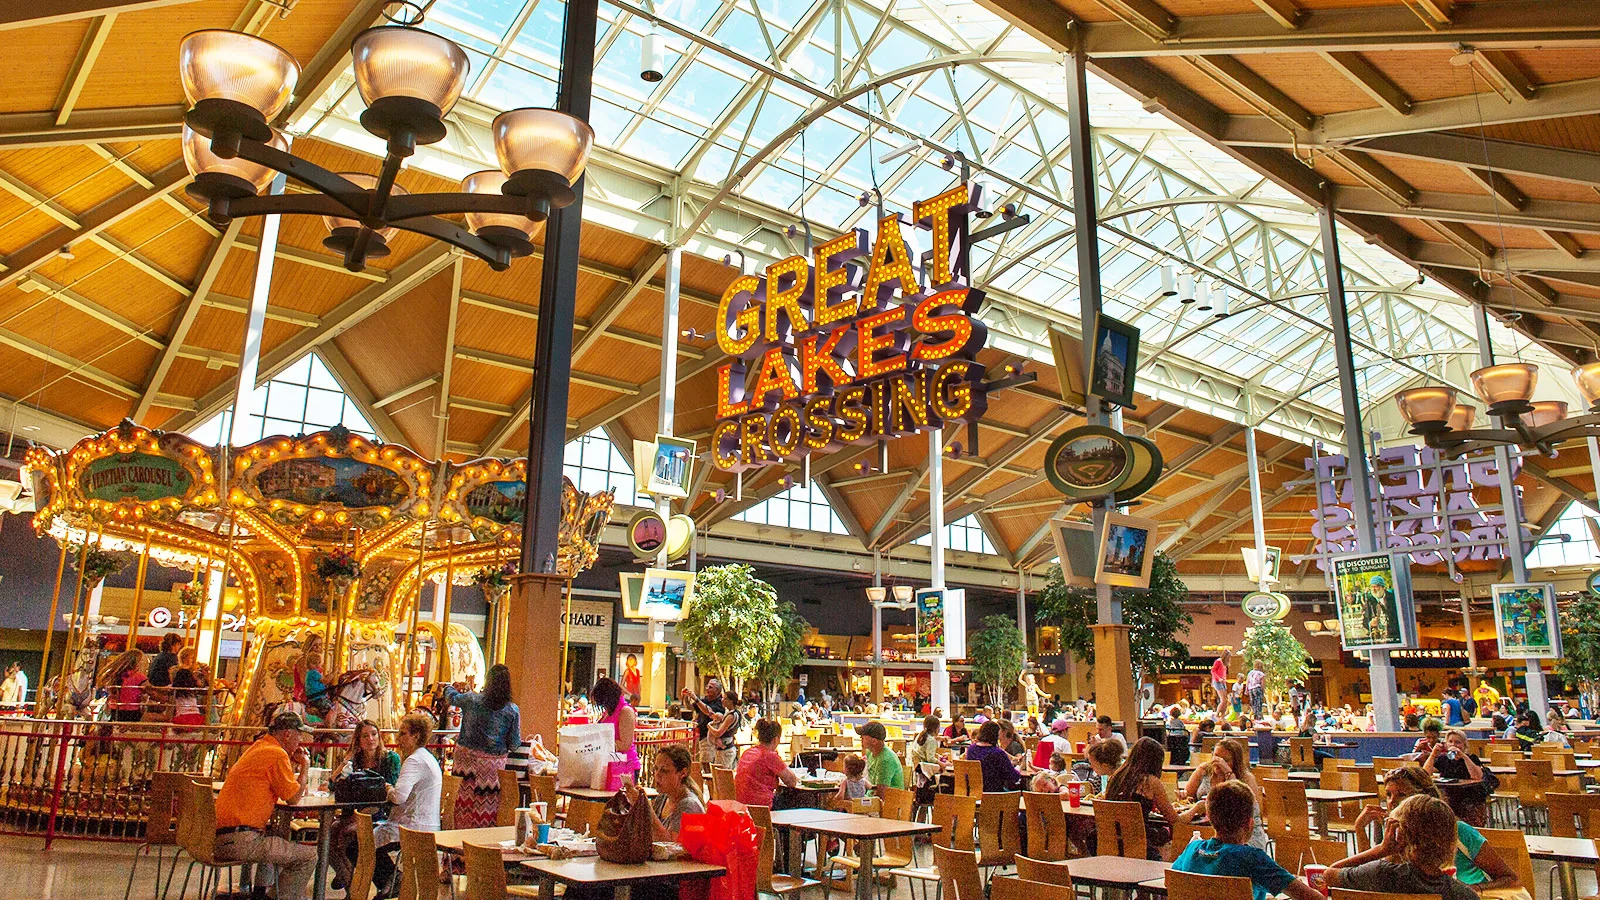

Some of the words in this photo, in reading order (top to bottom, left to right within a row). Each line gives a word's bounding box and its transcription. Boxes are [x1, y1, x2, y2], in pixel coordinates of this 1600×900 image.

[716, 186, 969, 355] GREAT
[715, 288, 973, 420] LAKES
[712, 361, 972, 470] CROSSING
[92, 467, 127, 490] VENETIAN
[128, 466, 174, 487] CAROUSEL
[1346, 557, 1389, 568] DISCOVERED
[1400, 650, 1433, 658] LAKES
[1439, 650, 1469, 658] WALK
